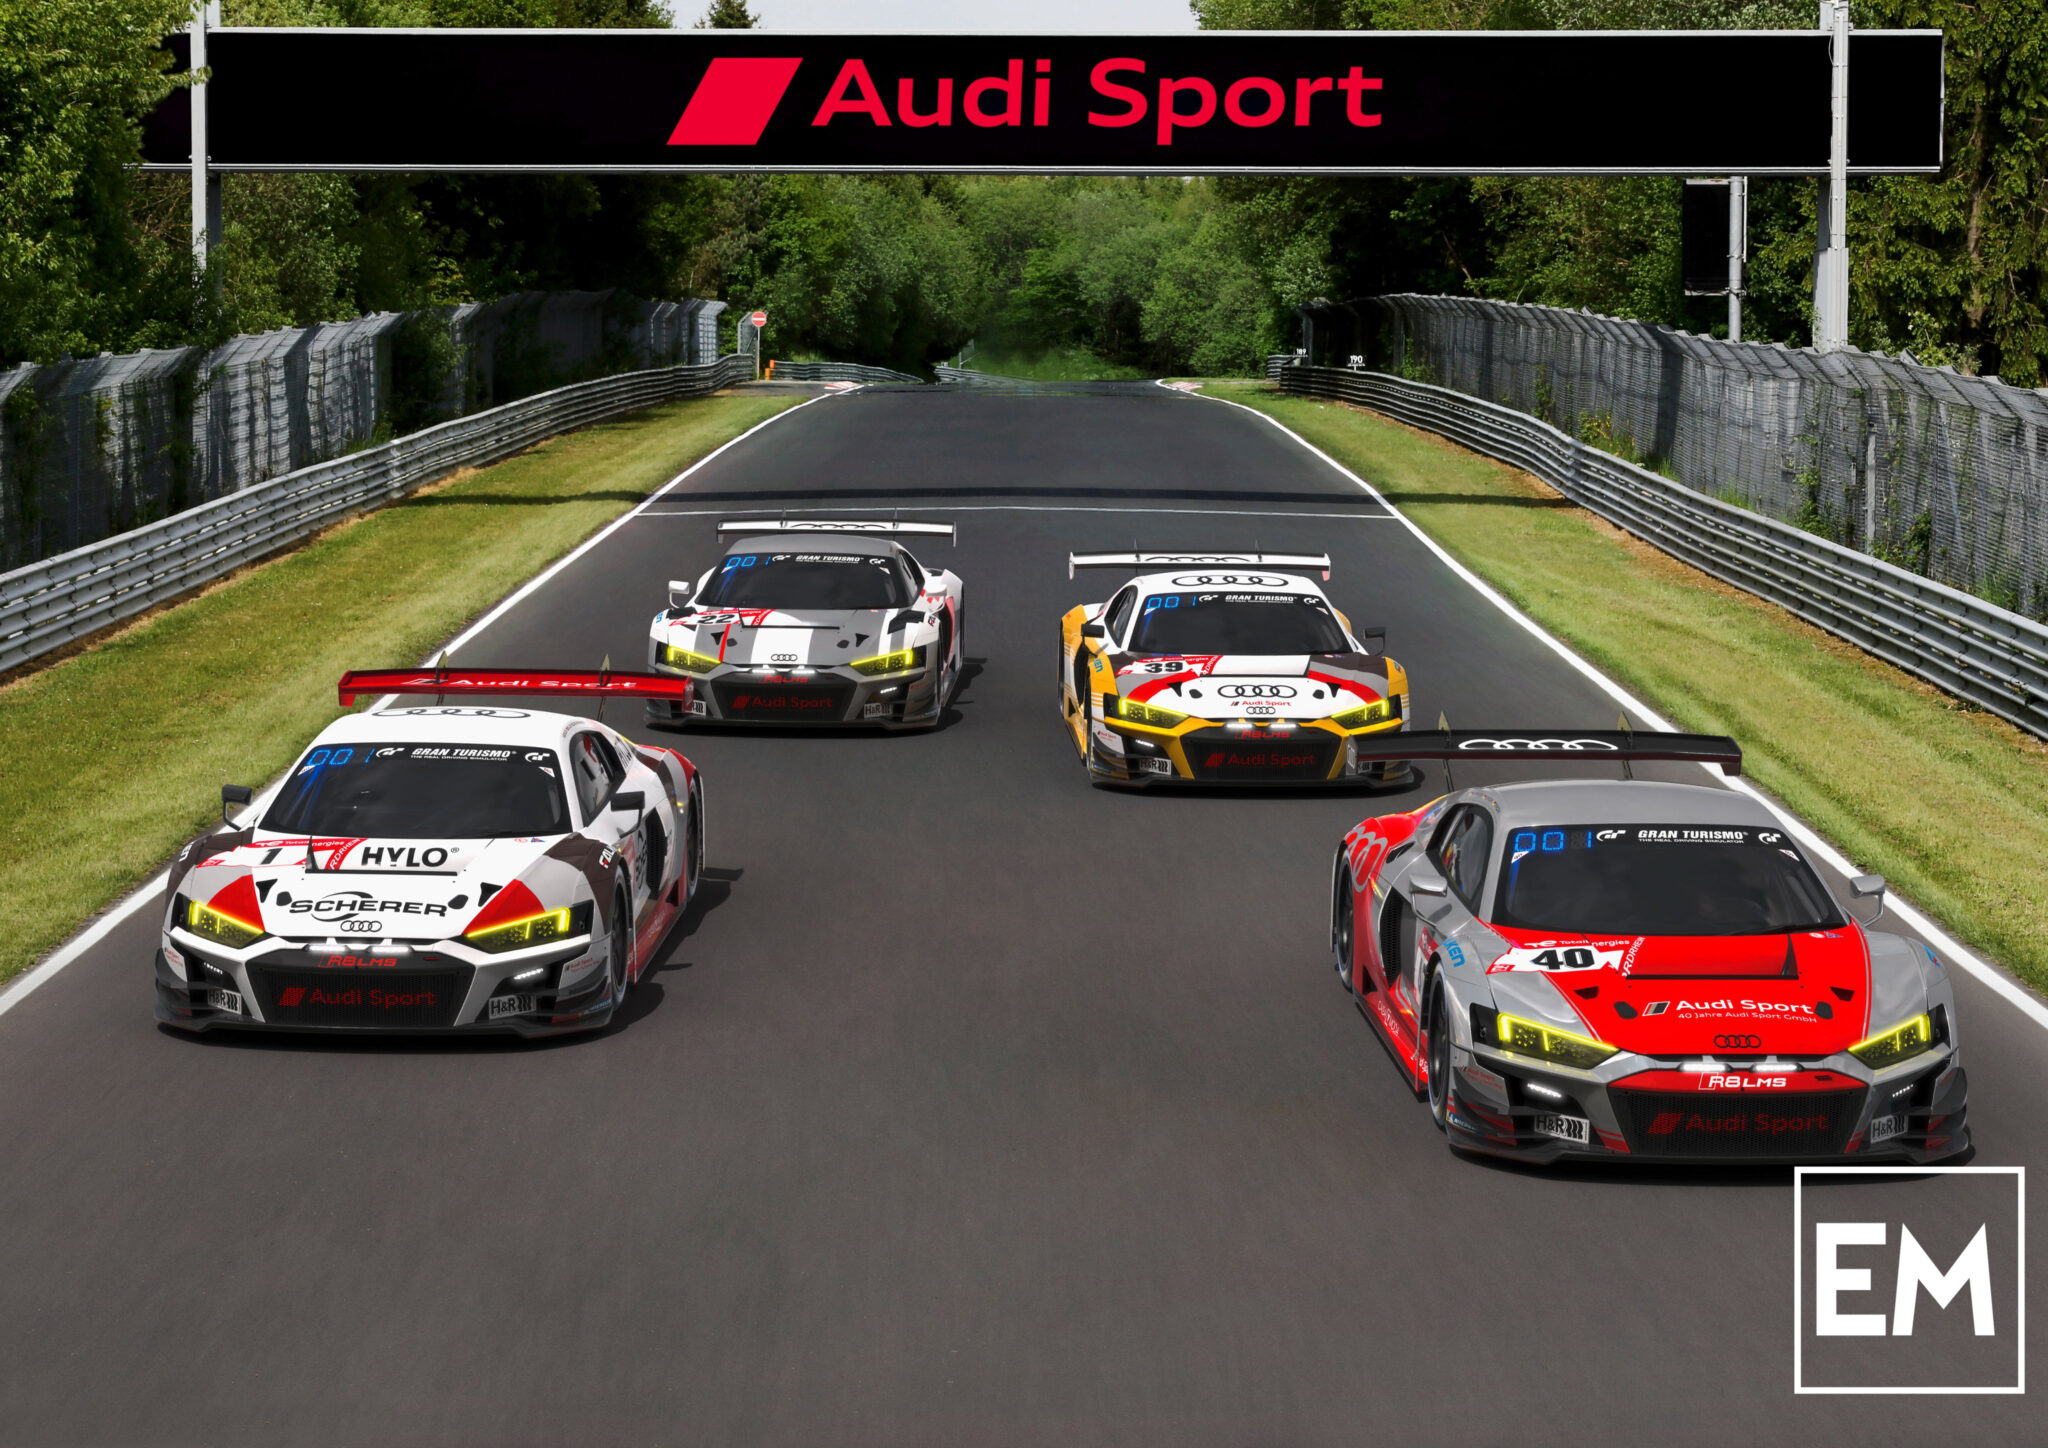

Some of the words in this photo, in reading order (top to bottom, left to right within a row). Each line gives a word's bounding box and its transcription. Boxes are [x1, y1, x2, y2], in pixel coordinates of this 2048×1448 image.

[811, 59, 1052, 127] Audi
[1088, 58, 1383, 145] Sport
[697, 614, 735, 624] 22
[1144, 662, 1183, 673] 39
[451, 679, 529, 687] Audi
[752, 696, 786, 708] Audi
[790, 696, 832, 710] Sport
[412, 748, 452, 756] GRAN
[453, 749, 511, 758] TURISMO
[1228, 753, 1265, 765] Audi
[1270, 754, 1316, 767] Sport
[1638, 830, 1678, 839] GRAN
[1683, 830, 1743, 840] TURISMO
[260, 848, 283, 865] 1
[289, 900, 448, 917] SCHERER
[1531, 948, 1595, 970] 40
[310, 989, 361, 1005] Audi
[369, 989, 437, 1009] Sport
[1676, 1000, 1734, 1010] Audi
[1740, 1000, 1814, 1014] Sport
[1752, 1012, 1782, 1020] Sport
[1783, 1014, 1817, 1023] GmbH
[1686, 1114, 1746, 1131] Audi
[1755, 1114, 1828, 1135] Sport
